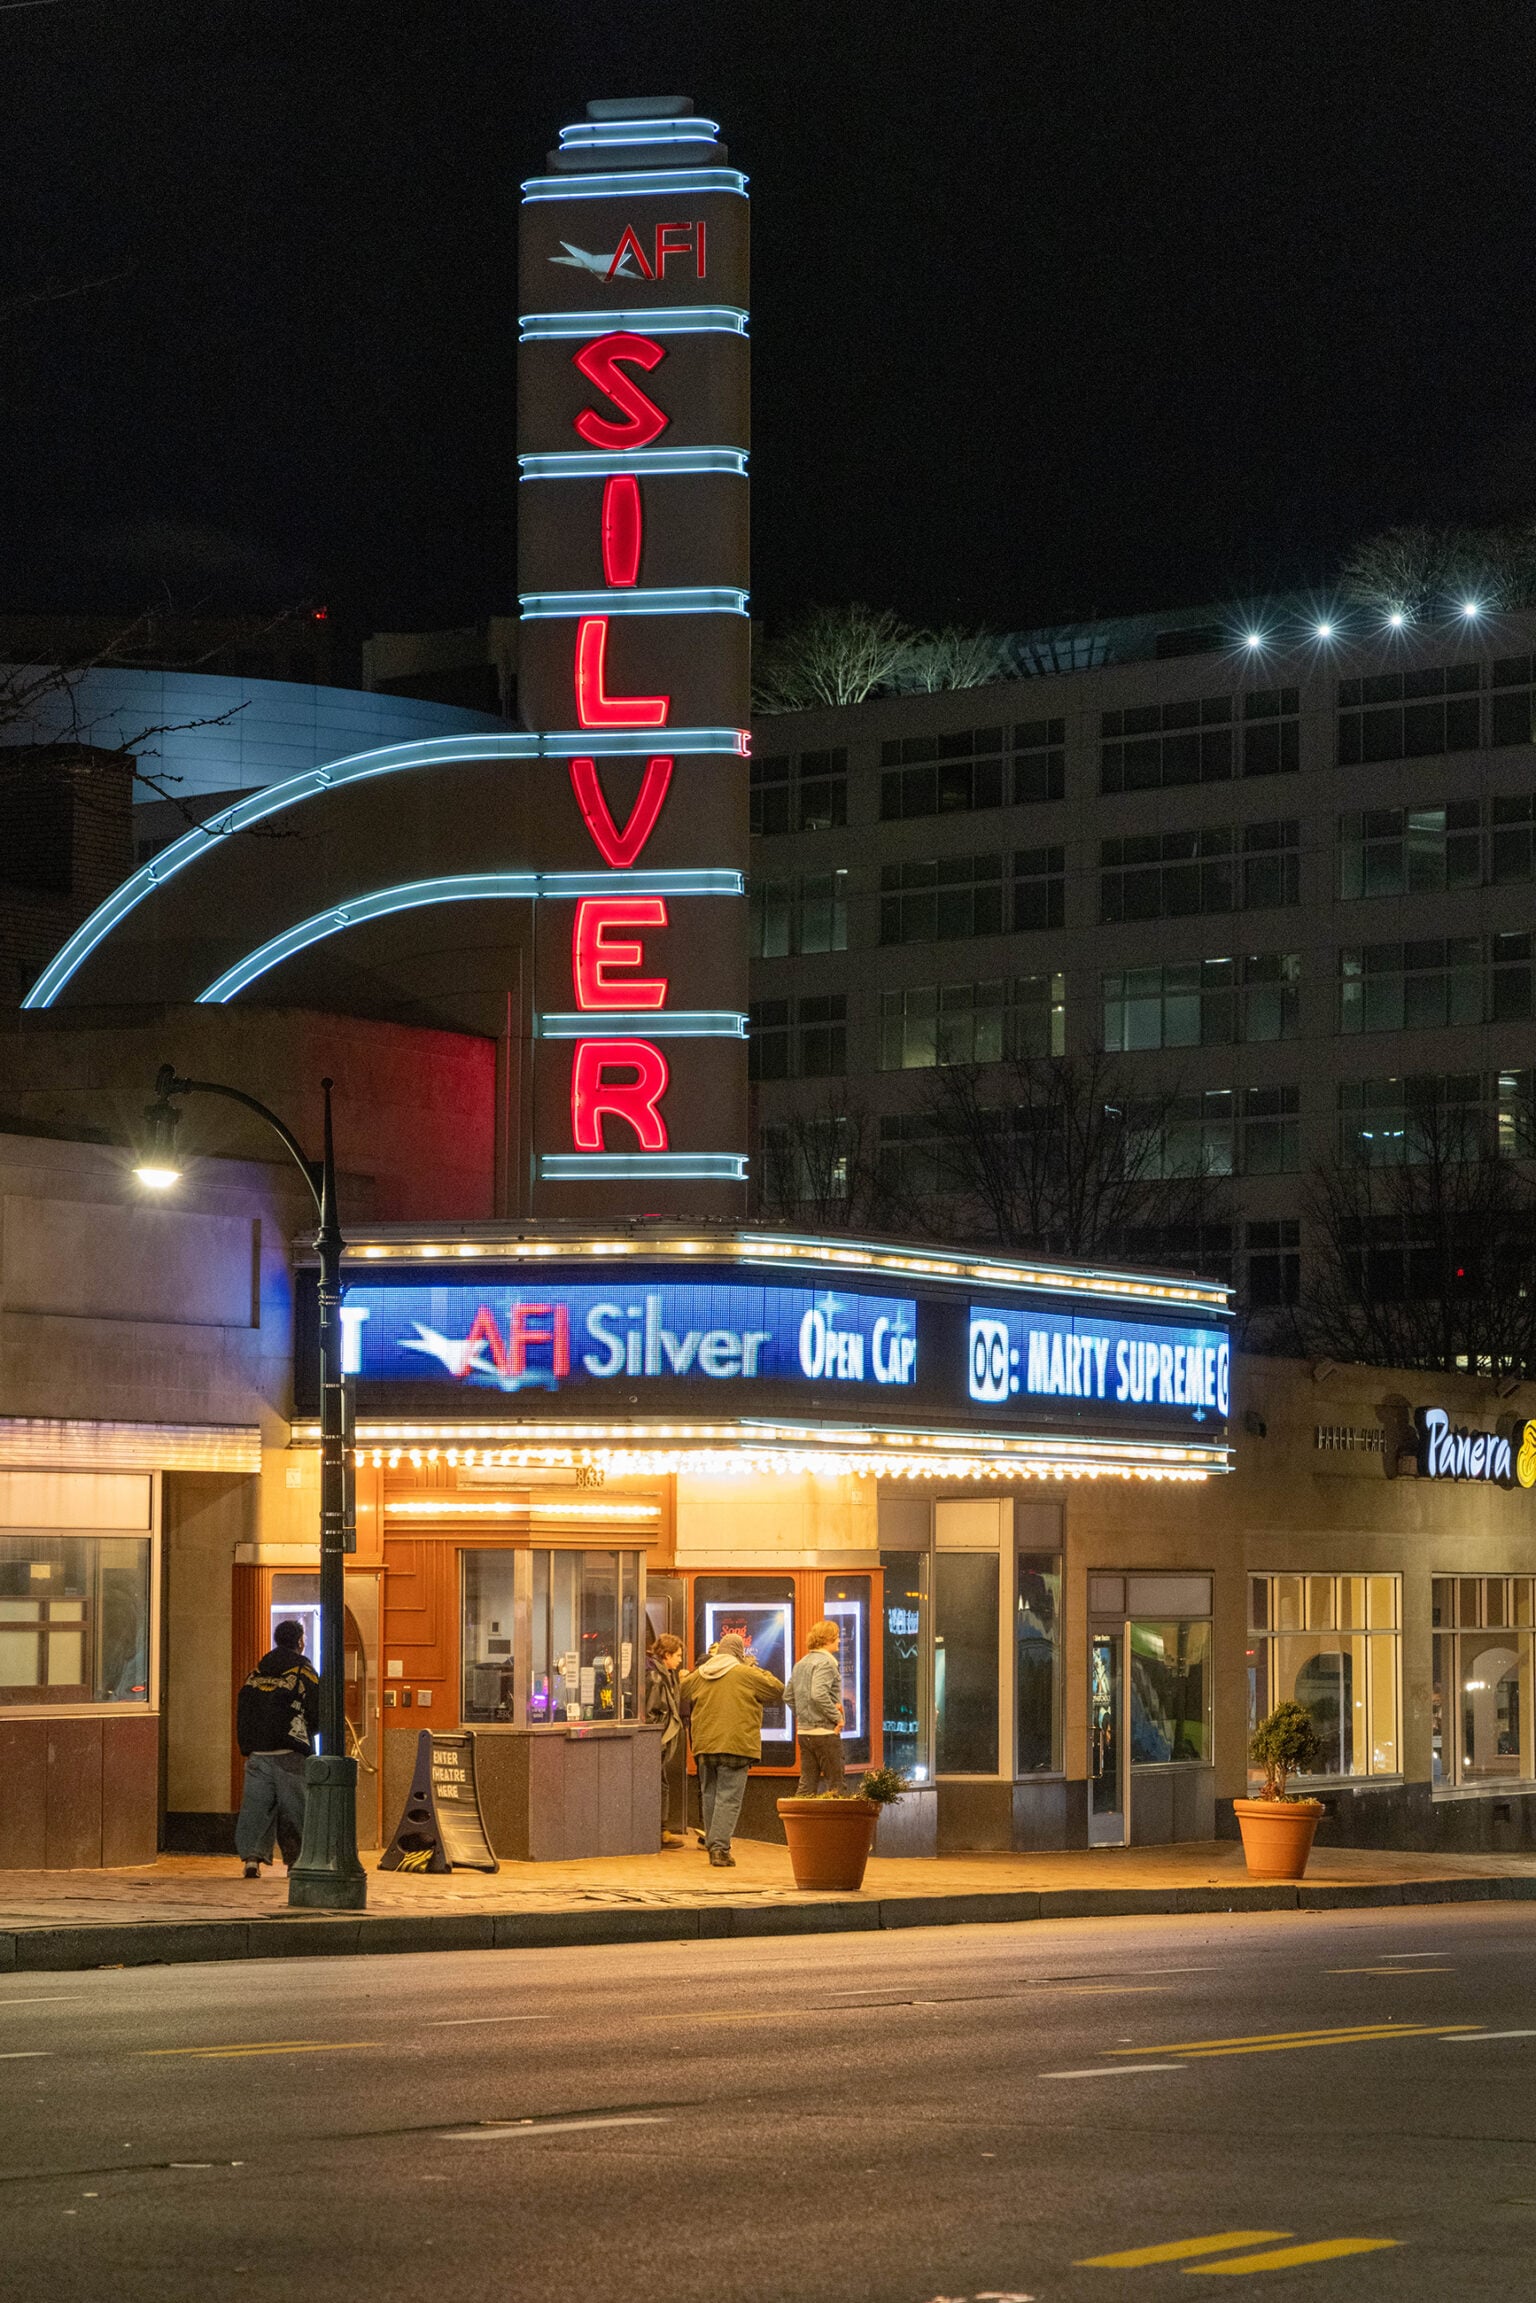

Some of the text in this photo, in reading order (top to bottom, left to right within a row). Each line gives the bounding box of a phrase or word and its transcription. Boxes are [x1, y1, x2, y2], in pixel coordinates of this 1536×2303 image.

[605, 221, 707, 282] AFI
[569, 330, 675, 1152] SILVER
[458, 1303, 571, 1378] AFI
[583, 1294, 772, 1379] Silver
[1027, 1329, 1110, 1399] MARTY
[1116, 1338, 1216, 1407] SUPREME
[1426, 1407, 1511, 1480] Panera
[433, 1750, 459, 1766] ENTER
[436, 1784, 459, 1799] HERE
